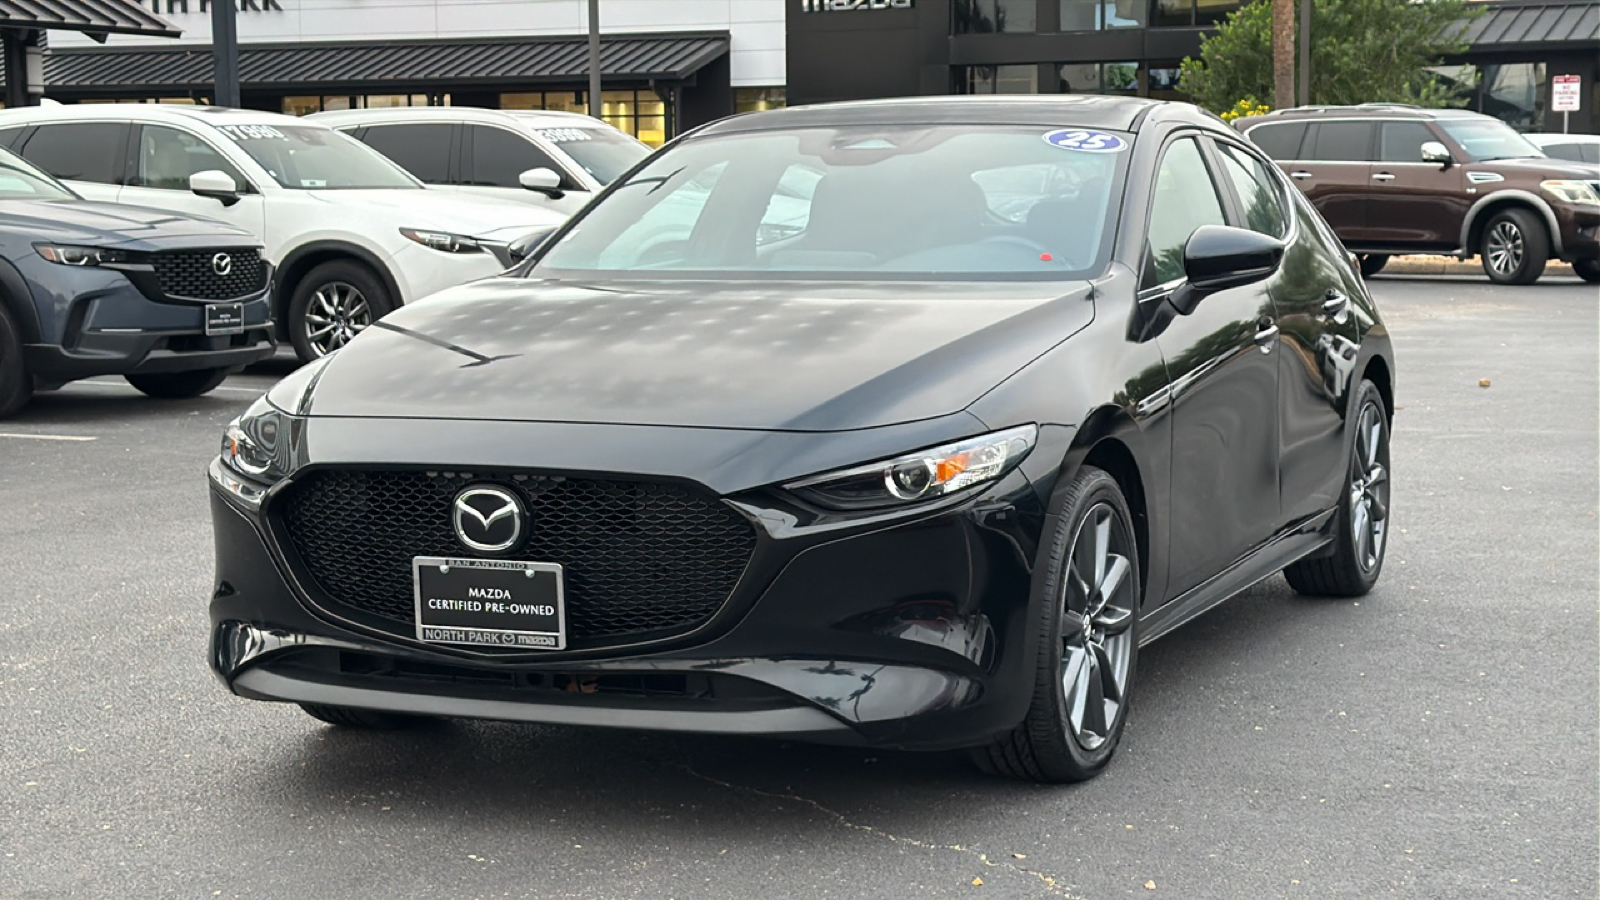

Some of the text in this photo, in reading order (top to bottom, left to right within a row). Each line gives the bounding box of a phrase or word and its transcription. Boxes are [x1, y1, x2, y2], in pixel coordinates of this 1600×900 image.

[1058, 132, 1112, 149] 25
[449, 559, 526, 570] SAN ANTONIO
[468, 587, 512, 600] MAZDA
[428, 599, 555, 616] CERTIFIED PRE-OWNED
[425, 629, 556, 646] NORTH PARK mazda
